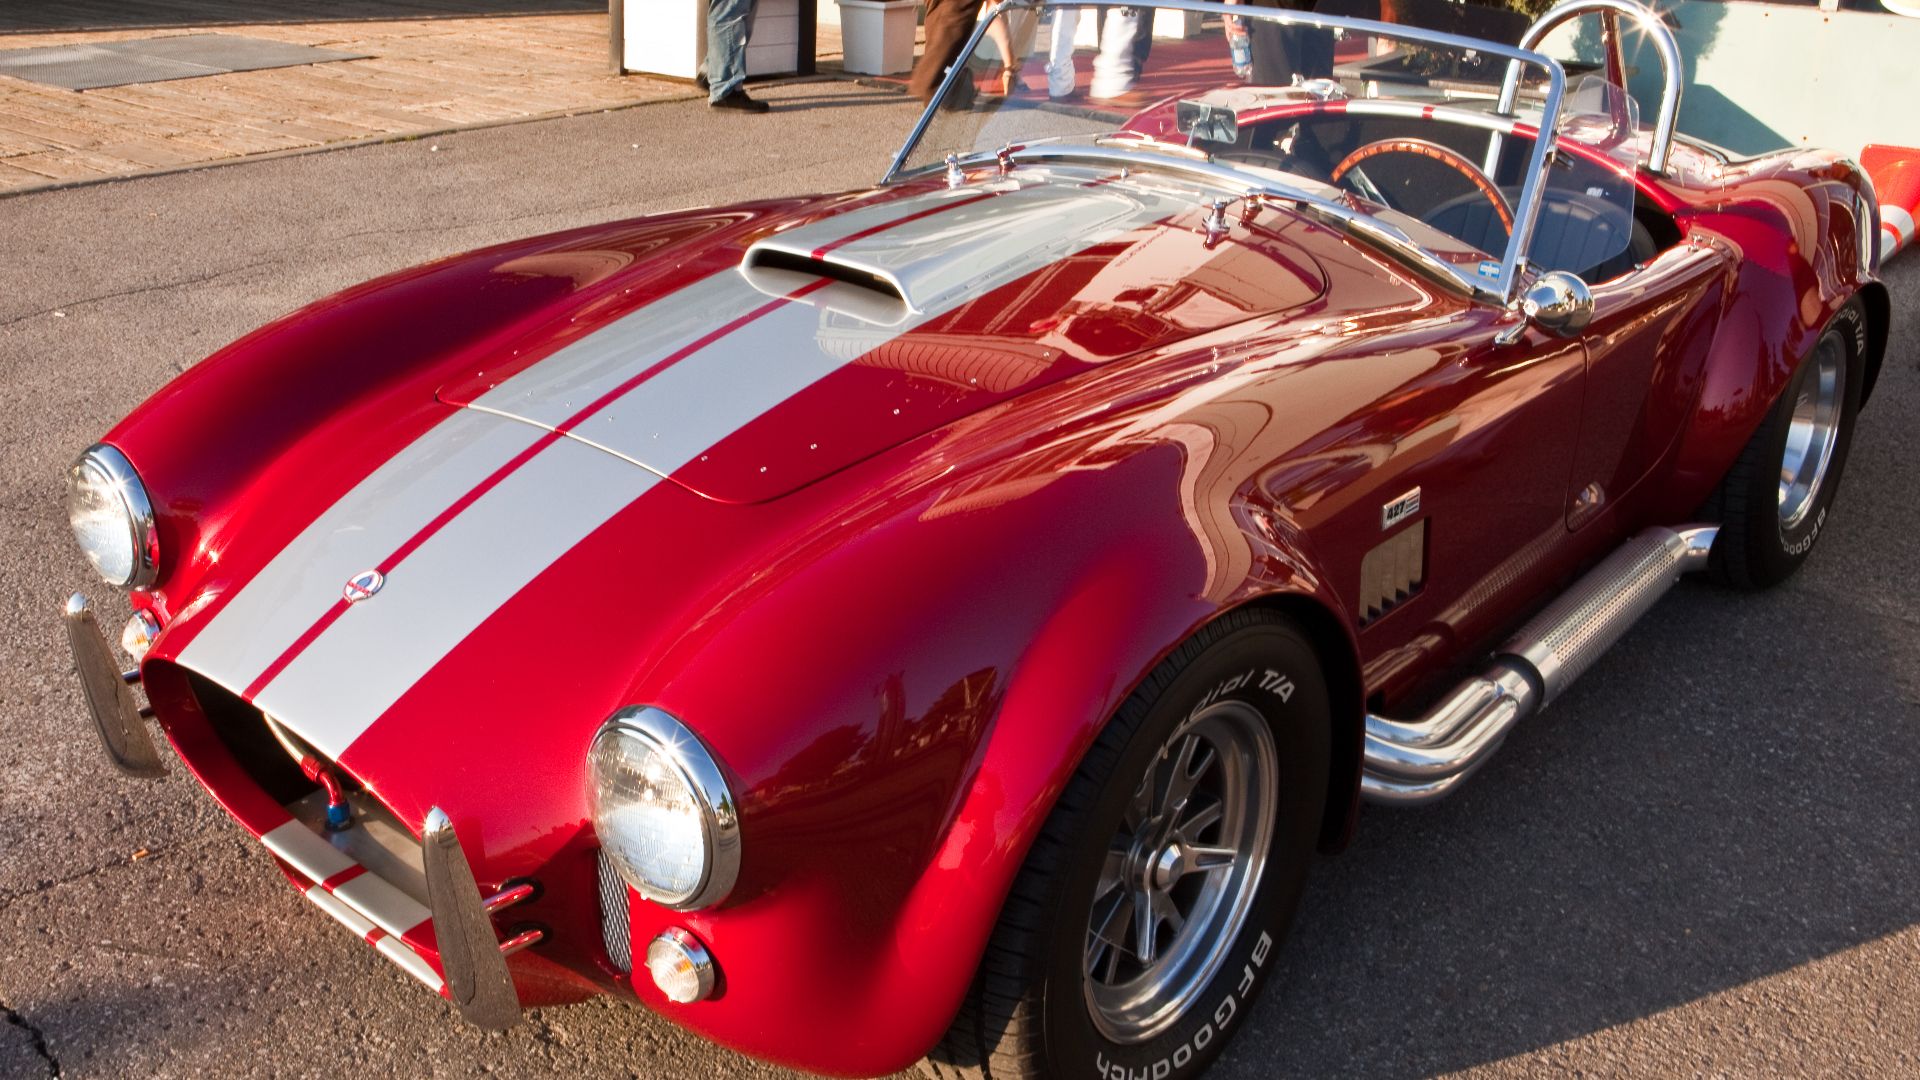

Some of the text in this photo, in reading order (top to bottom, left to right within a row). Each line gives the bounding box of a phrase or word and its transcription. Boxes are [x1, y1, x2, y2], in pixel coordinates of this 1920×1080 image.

[1854, 320, 1864, 357] T/A
[1387, 500, 1406, 520] 427
[1258, 669, 1296, 704] T/A
